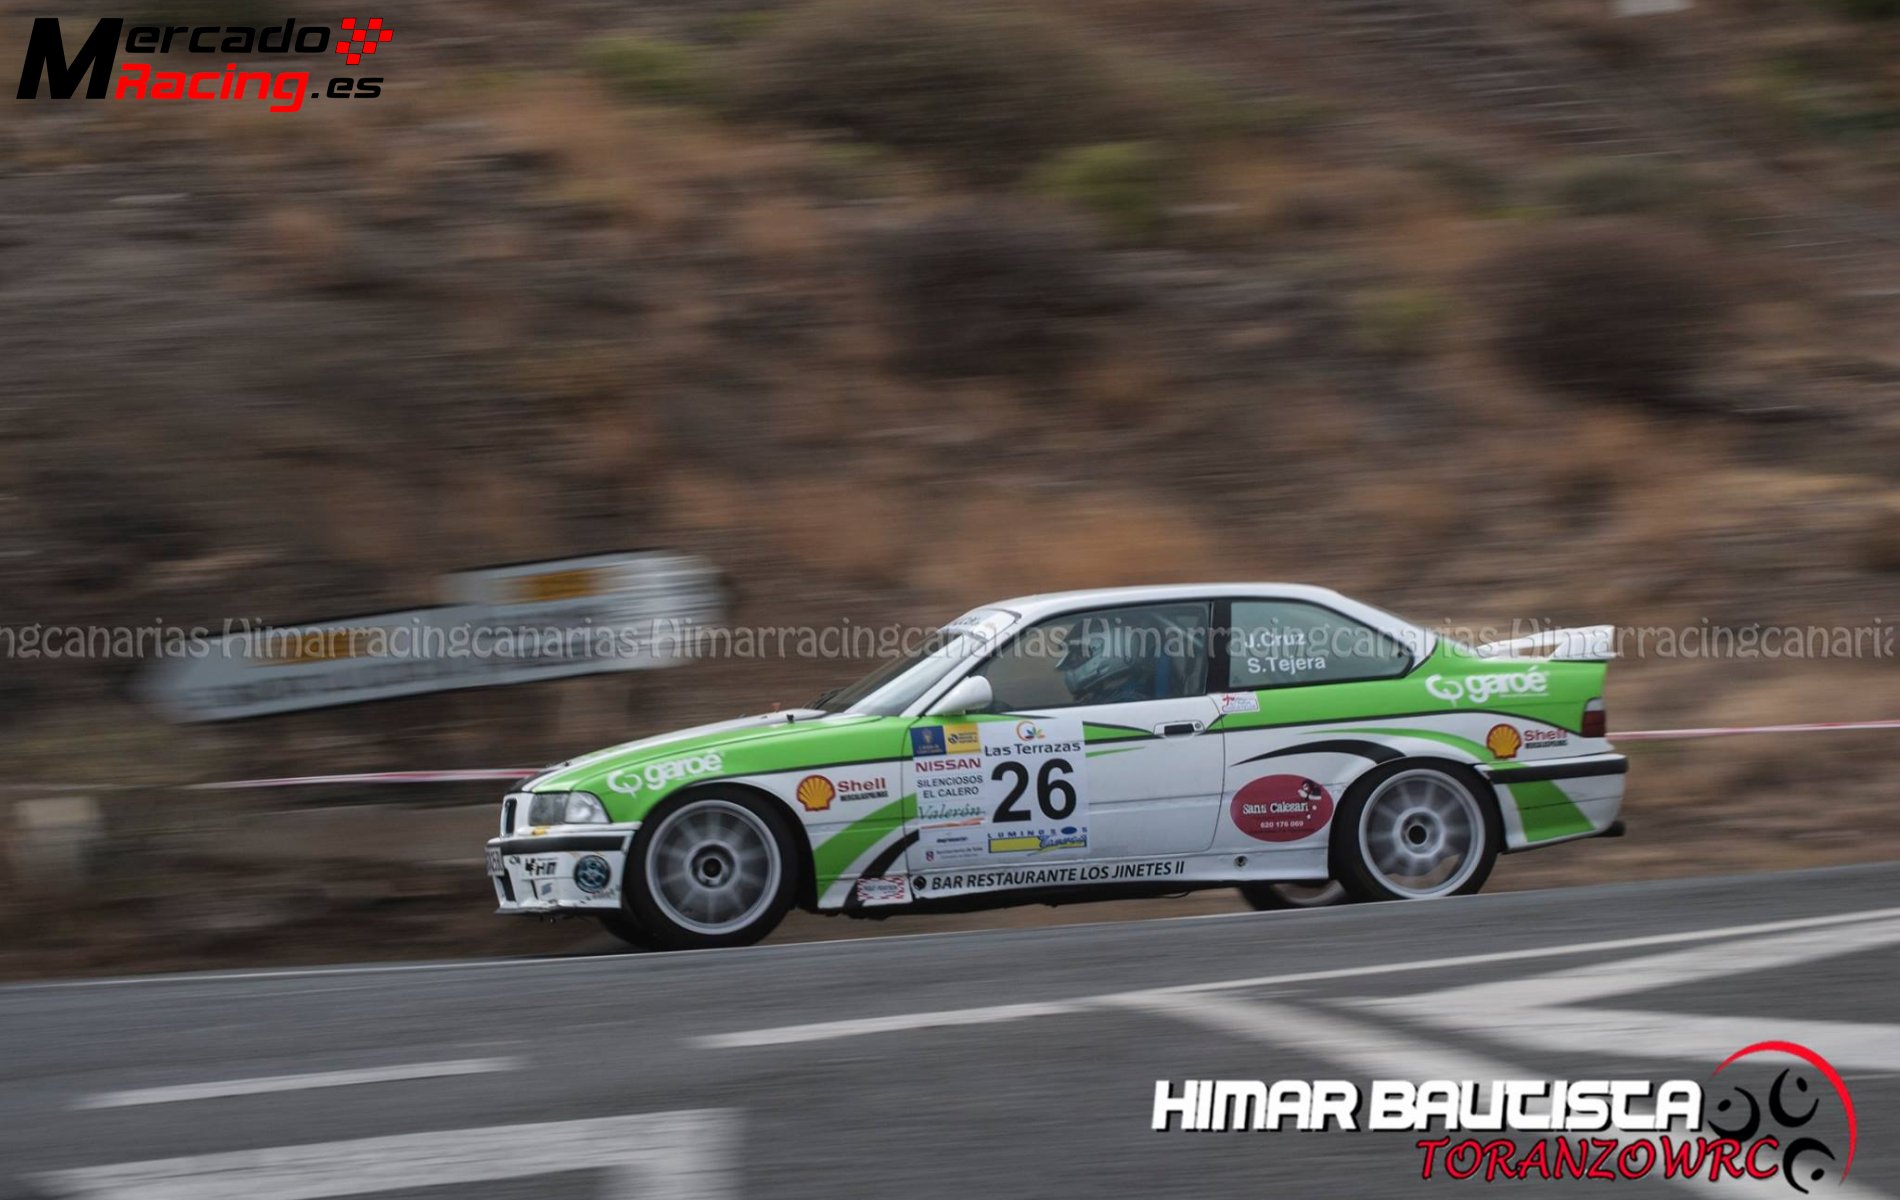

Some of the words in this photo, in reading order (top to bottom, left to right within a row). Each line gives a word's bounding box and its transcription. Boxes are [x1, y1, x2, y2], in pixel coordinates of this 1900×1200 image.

[1244, 632, 1305, 648] J.Cruz
[1247, 656, 1326, 675] S.Tejera
[1465, 665, 1548, 703] garoé
[985, 746, 1011, 757] Las
[1013, 742, 1081, 756] Terrazas
[915, 758, 981, 772] NISSAN
[838, 778, 886, 792] Shell
[917, 774, 983, 788] SILENCIOSOS
[923, 789, 935, 799] EL
[938, 786, 979, 797] CALERO
[991, 758, 1077, 823] 26
[932, 876, 962, 890] BAR
[967, 868, 1076, 888] RESTAURANTE
[1080, 866, 1109, 881] LOS
[1112, 861, 1171, 879] JINETES
